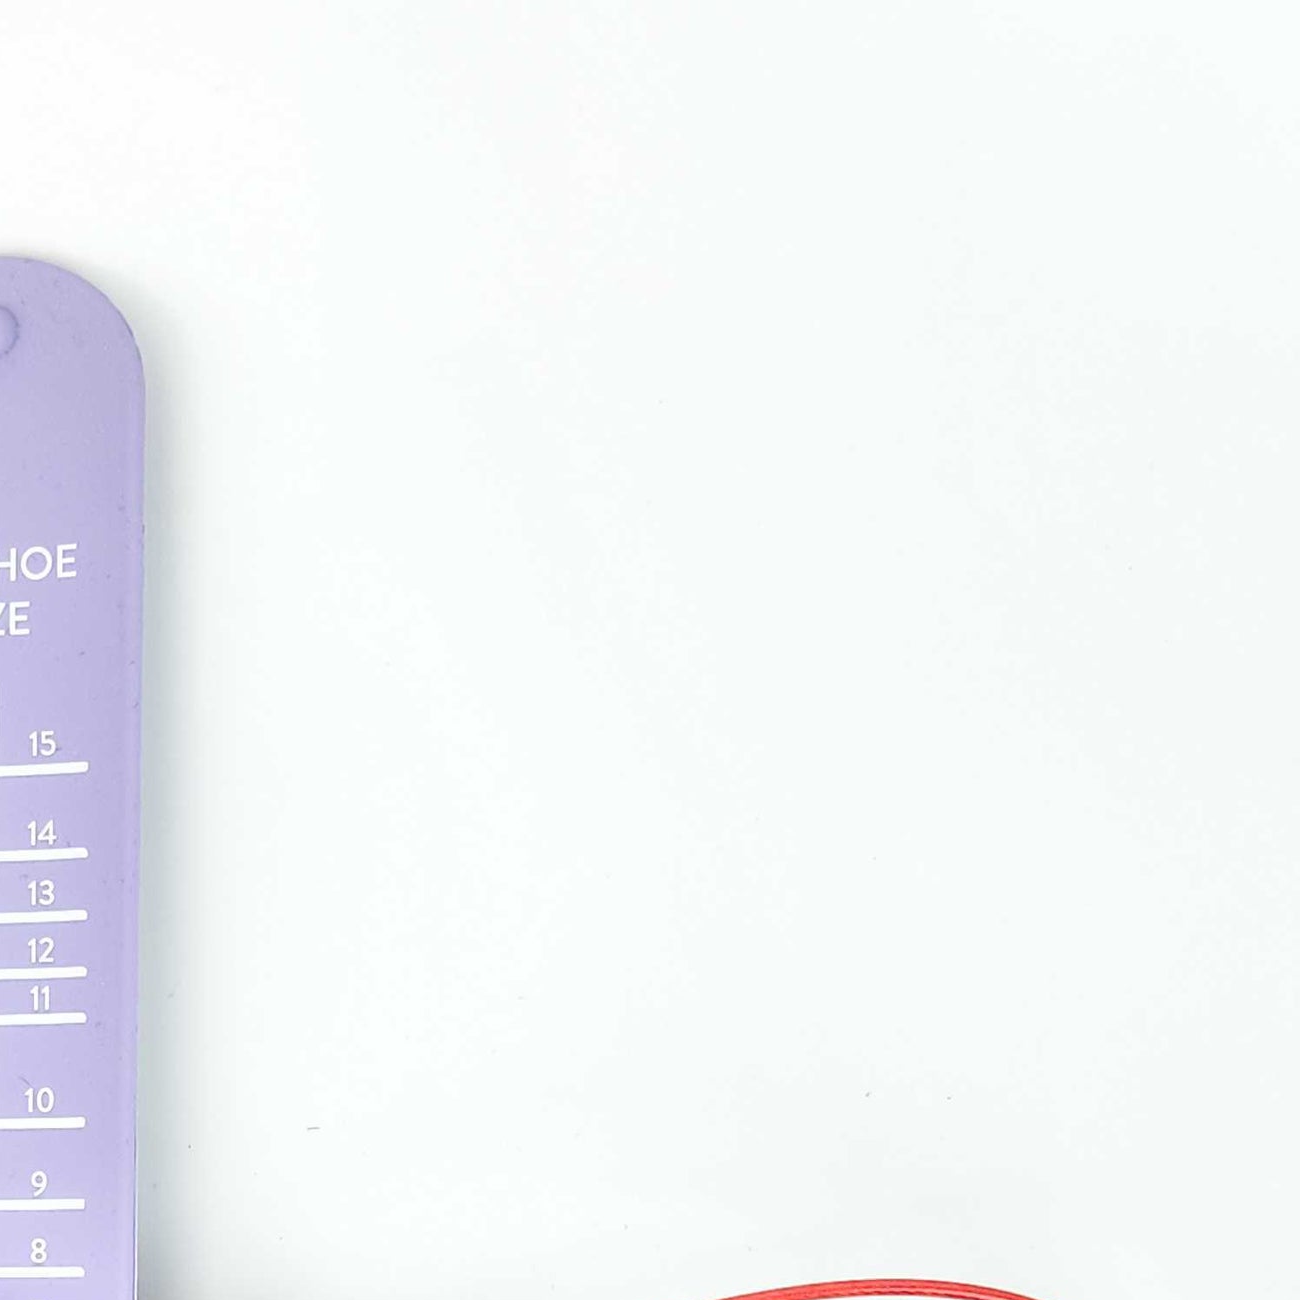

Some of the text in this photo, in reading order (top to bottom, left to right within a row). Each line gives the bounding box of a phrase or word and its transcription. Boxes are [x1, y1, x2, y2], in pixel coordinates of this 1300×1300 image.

[28, 730, 57, 757] 15
[27, 819, 58, 847] 14
[27, 879, 55, 906] 13
[27, 936, 55, 964] 12
[29, 984, 50, 1011] 11
[23, 1086, 55, 1113] 10
[29, 1170, 48, 1198] 9
[29, 1237, 48, 1265] 8
